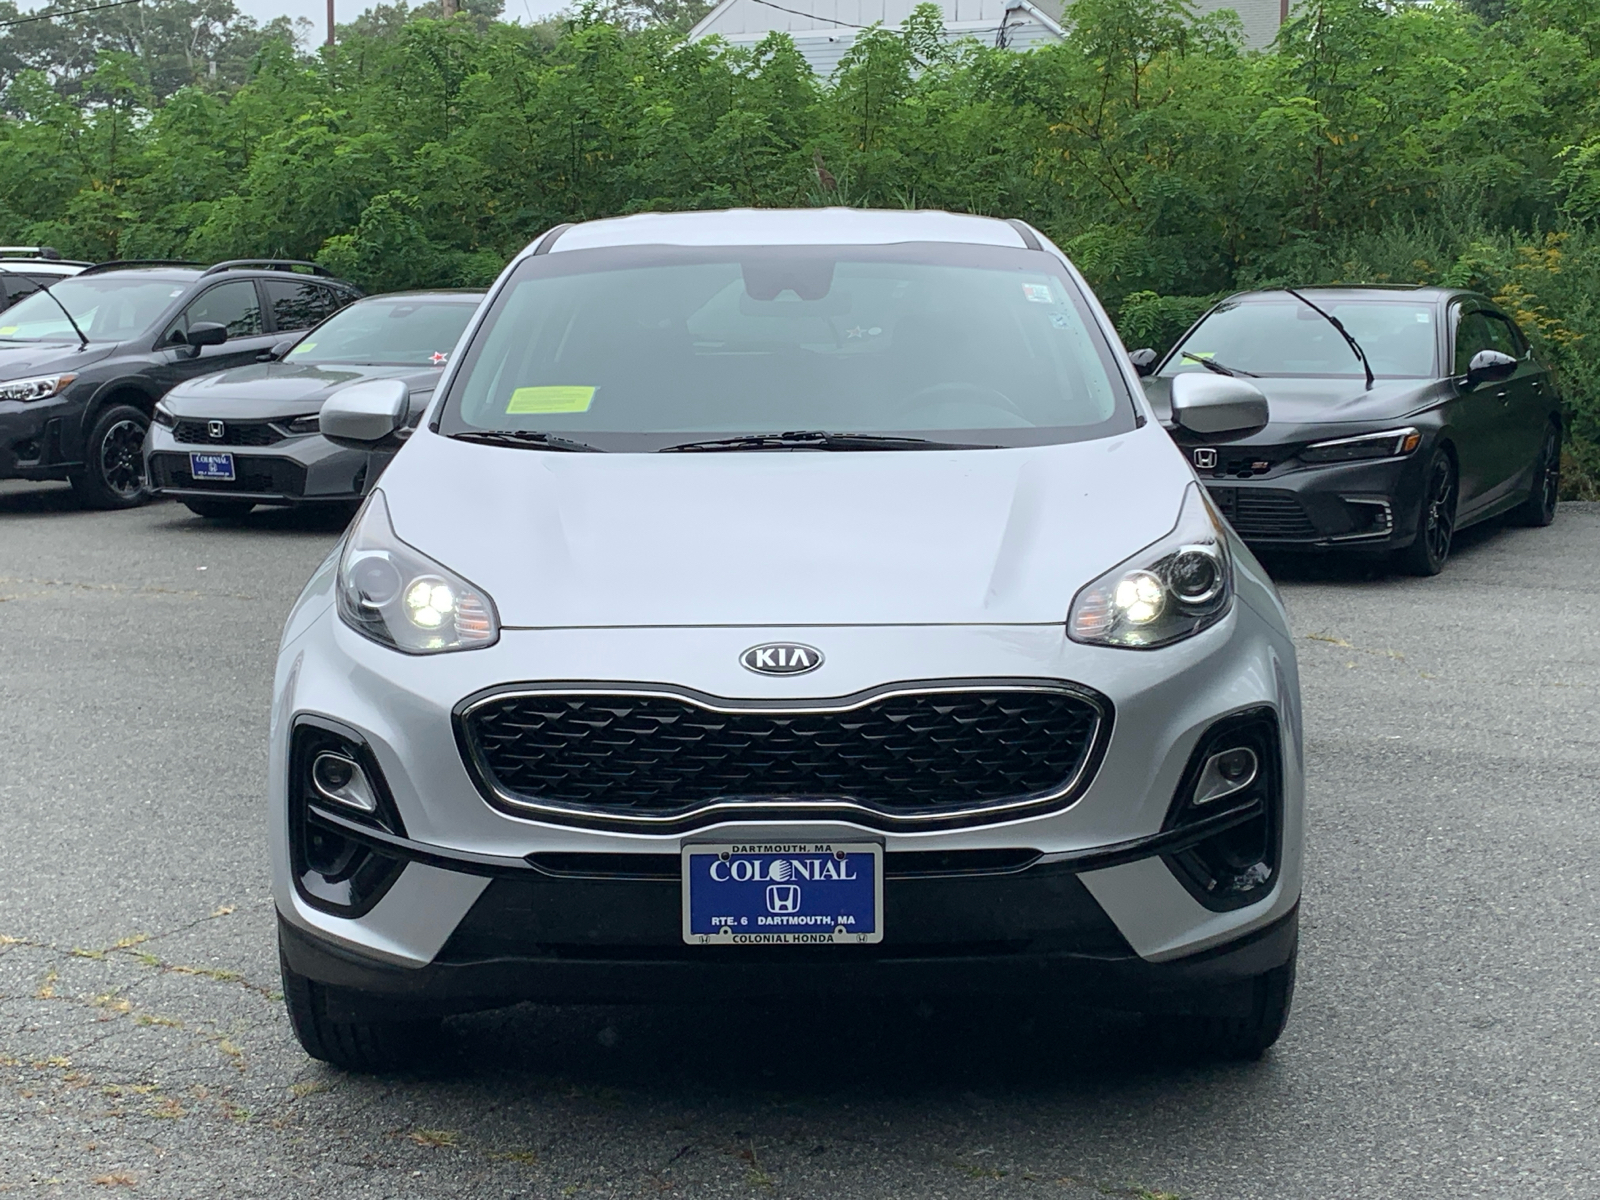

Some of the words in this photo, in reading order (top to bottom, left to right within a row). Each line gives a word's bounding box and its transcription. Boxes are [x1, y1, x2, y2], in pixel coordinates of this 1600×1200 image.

[756, 648, 811, 668] KIA
[732, 845, 811, 853] DARTMOUTH,
[814, 844, 833, 852] MA
[709, 859, 857, 882] COLONIAL
[711, 917, 738, 926] RTE.
[740, 917, 748, 926] 6
[757, 916, 835, 927] DARTMOUTH,
[837, 915, 856, 925] MA
[732, 935, 789, 944] COLONIAL
[794, 934, 834, 943] HONDA
